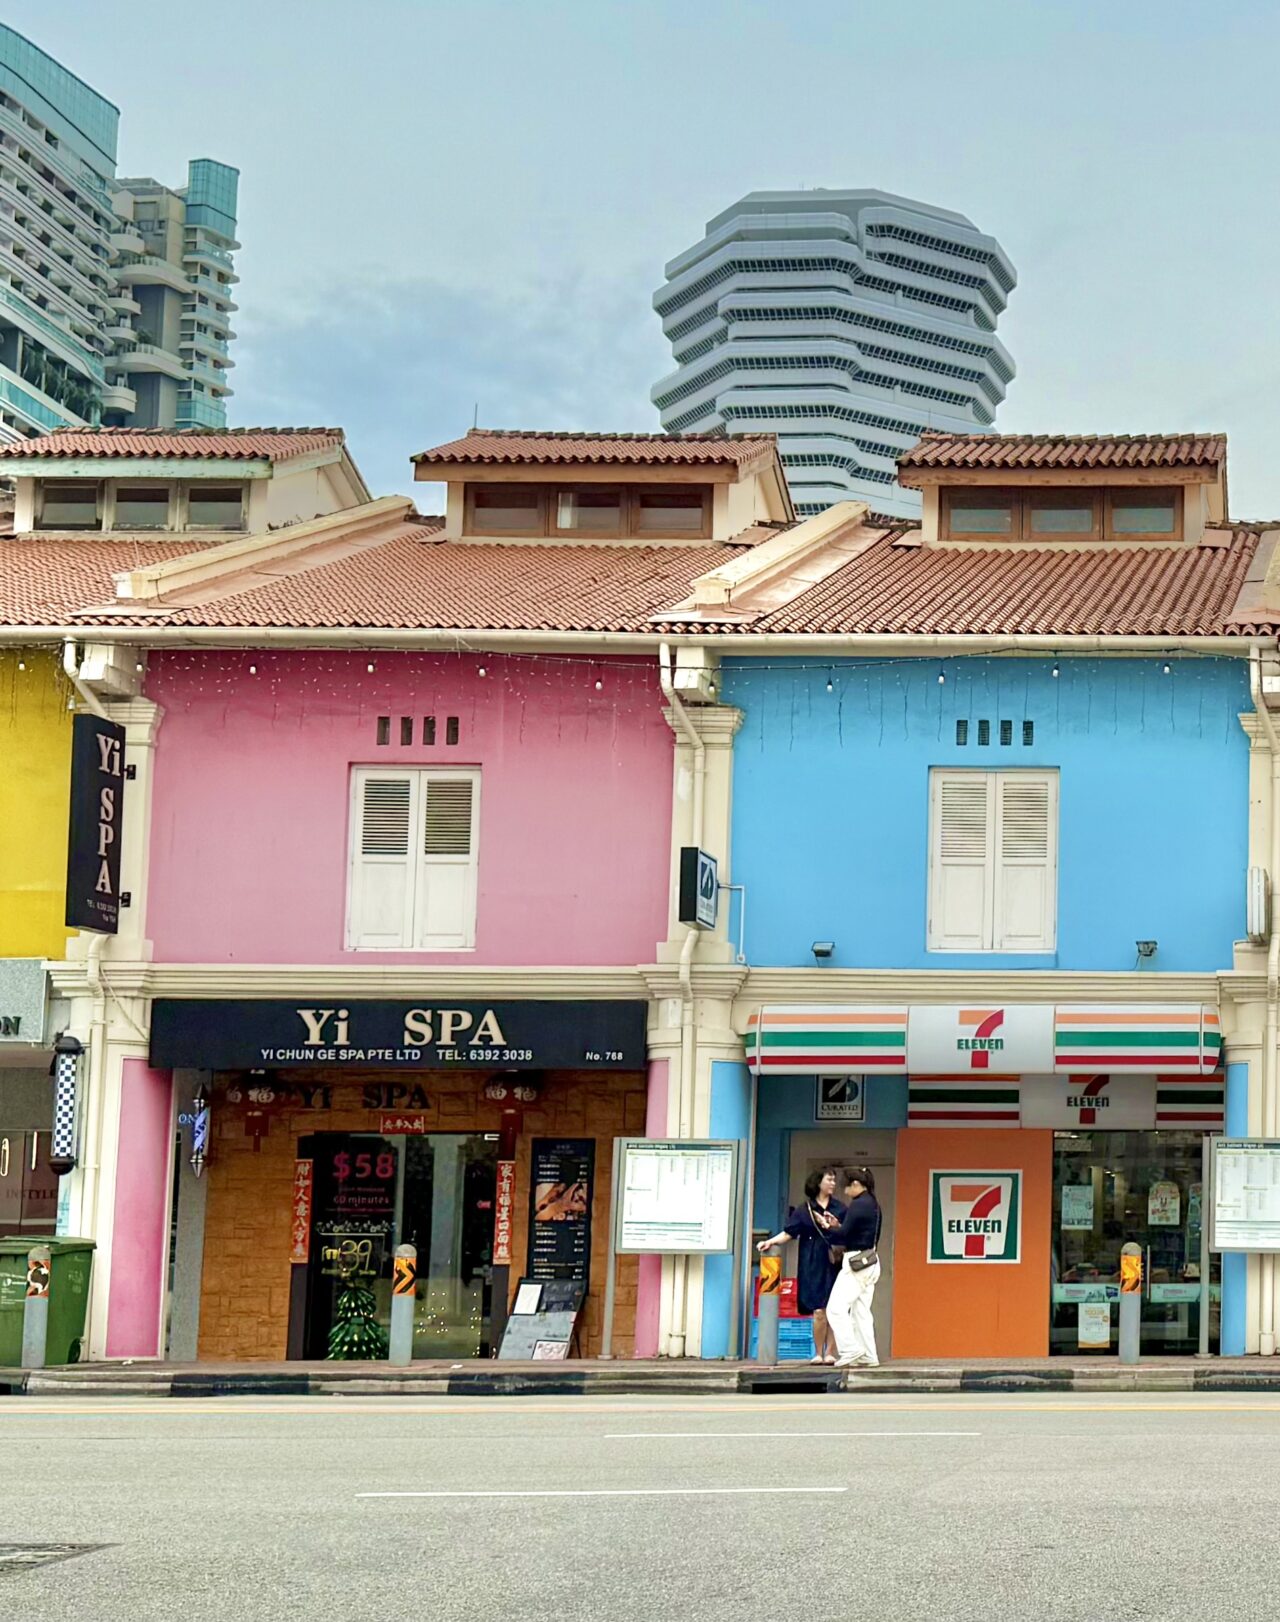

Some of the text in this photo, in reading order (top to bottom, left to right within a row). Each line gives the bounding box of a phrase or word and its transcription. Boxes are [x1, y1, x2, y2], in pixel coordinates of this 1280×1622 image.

[96, 732, 121, 777] Yi
[95, 786, 115, 895] SPA
[0, 1015, 22, 1036] N
[297, 1008, 507, 1046] Yi SPA
[261, 1049, 533, 1061] YI CHUN GE SPA PTE LTD TEL: 6392 3038
[586, 1051, 624, 1061] No. 768
[363, 1081, 431, 1110] SPA
[332, 1151, 395, 1182] $58
[950, 1184, 1002, 1257] 7
